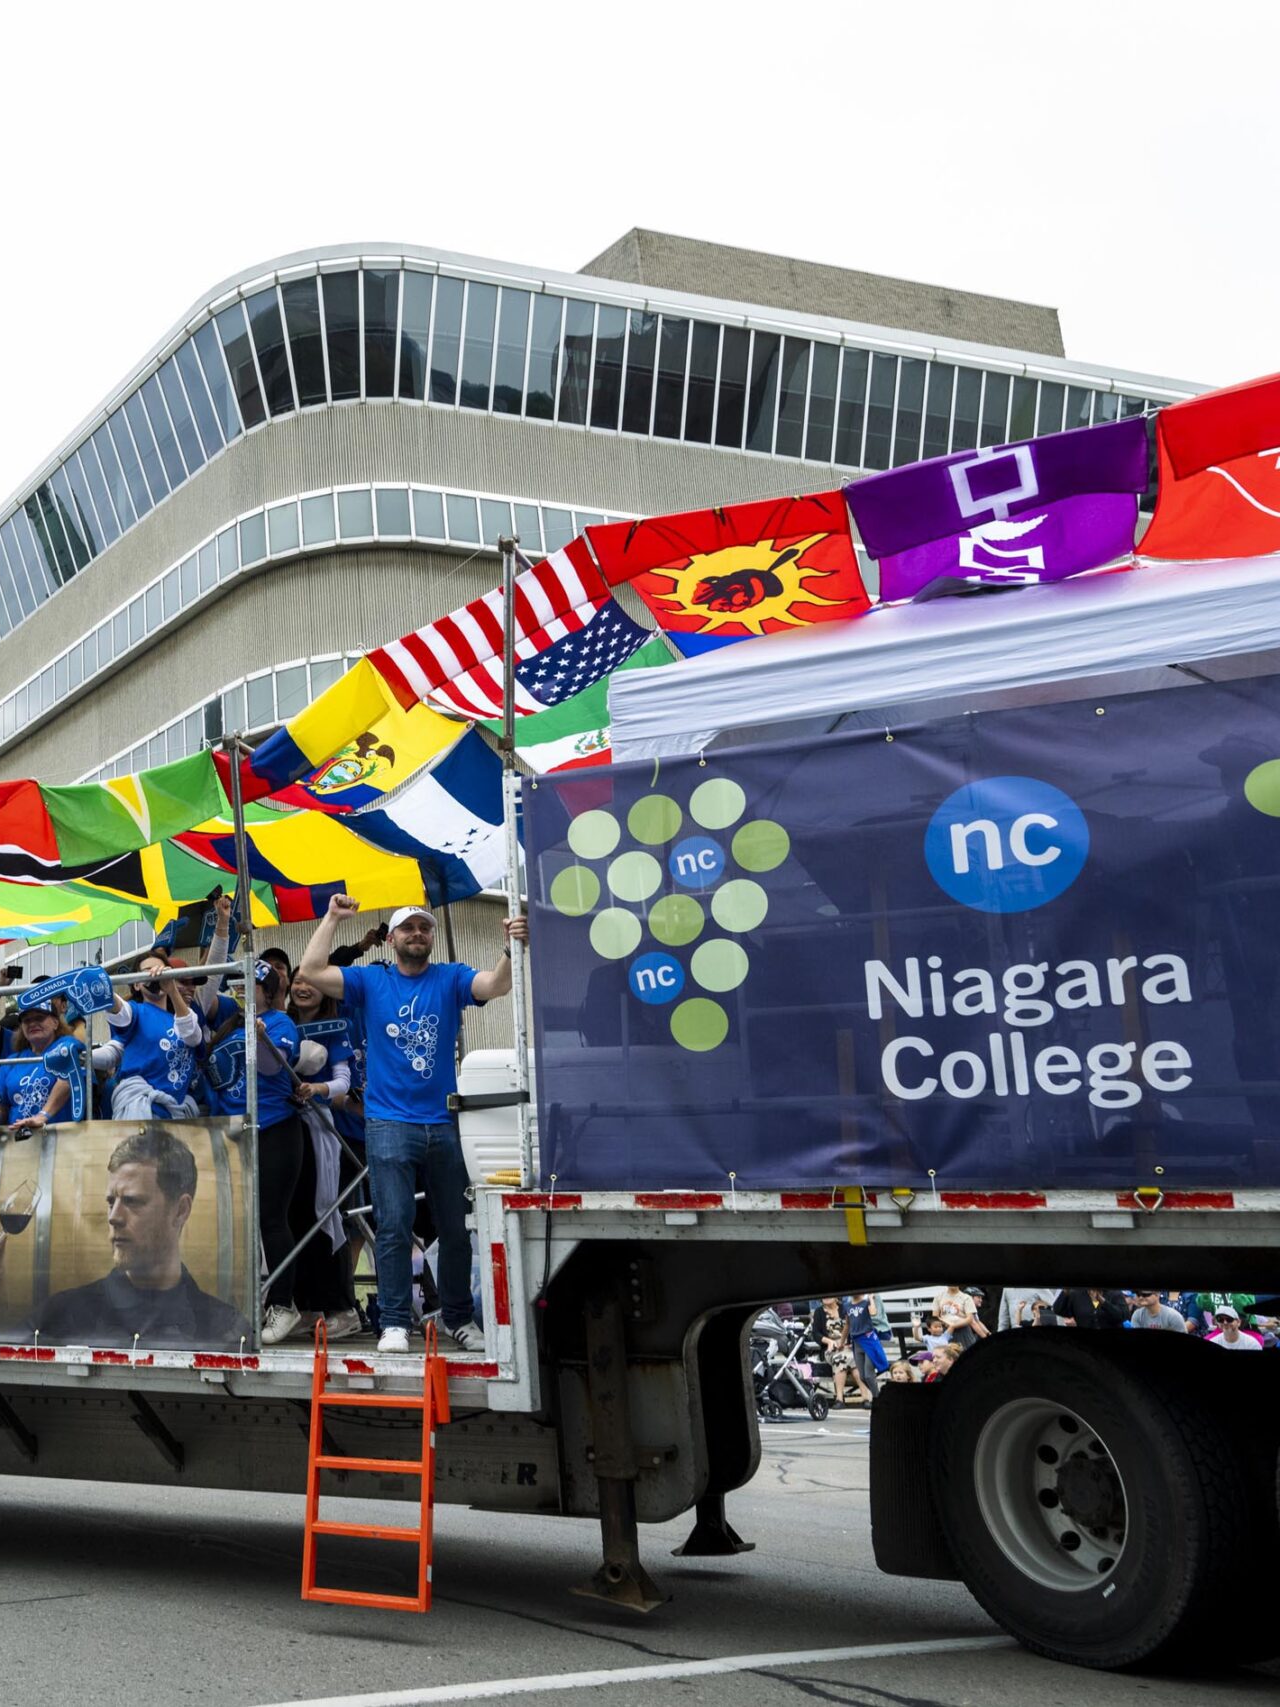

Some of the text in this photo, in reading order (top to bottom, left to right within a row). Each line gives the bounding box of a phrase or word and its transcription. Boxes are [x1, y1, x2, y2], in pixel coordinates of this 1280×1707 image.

[677, 846, 716, 875] nc
[950, 813, 1061, 874] nc
[29, 979, 68, 1000] GO CANADA
[636, 963, 677, 991] nc
[865, 954, 1193, 1028] Niagara
[881, 1032, 1193, 1109] College
